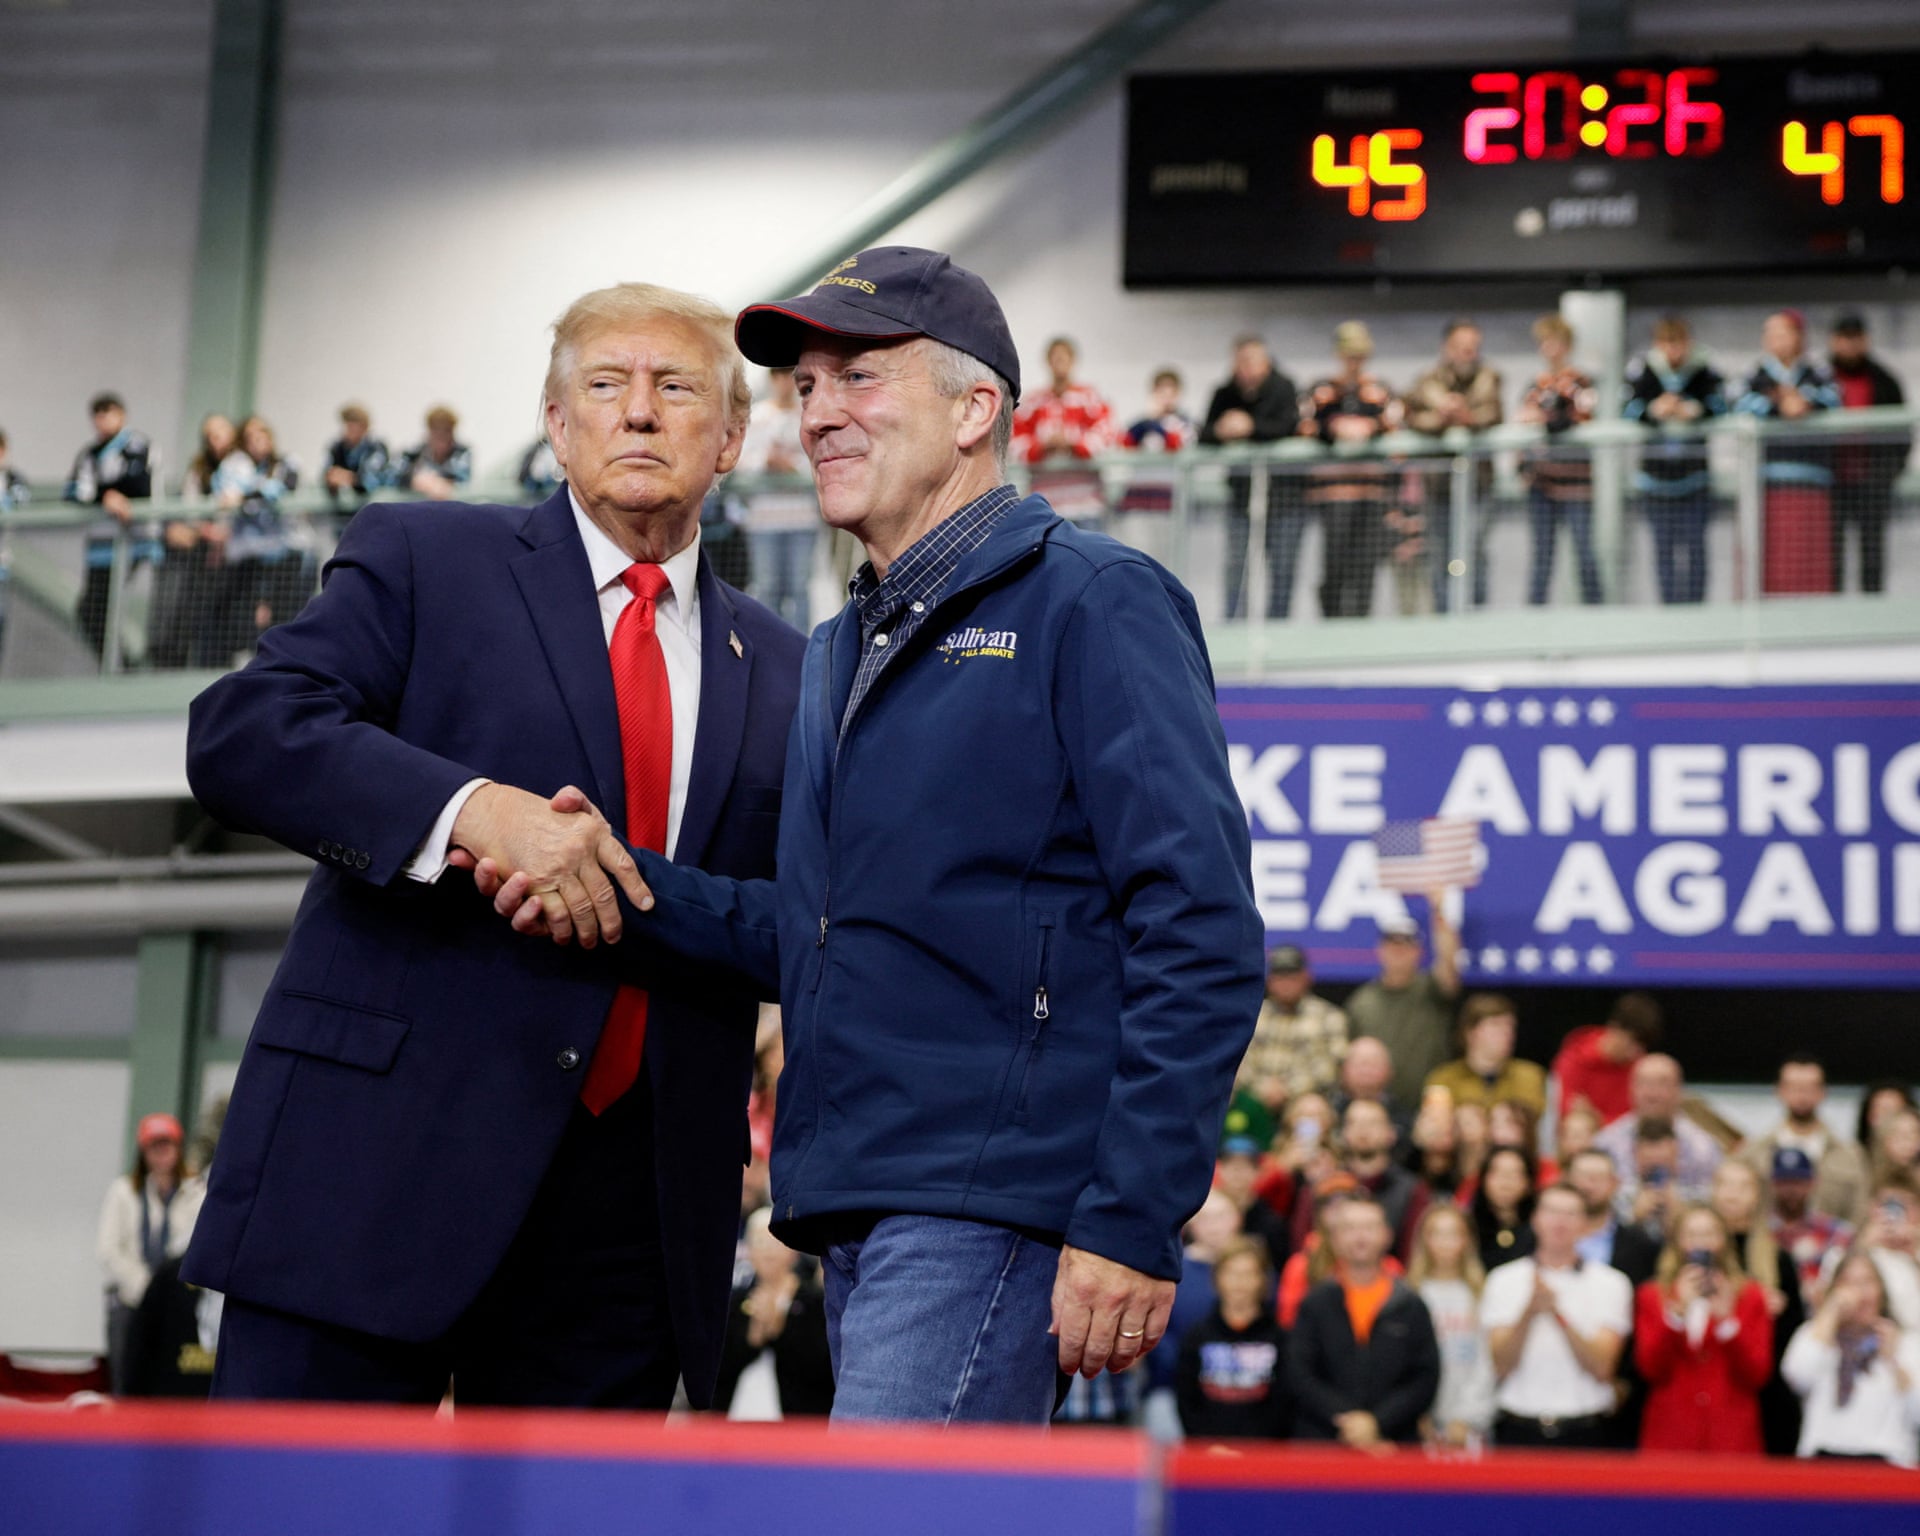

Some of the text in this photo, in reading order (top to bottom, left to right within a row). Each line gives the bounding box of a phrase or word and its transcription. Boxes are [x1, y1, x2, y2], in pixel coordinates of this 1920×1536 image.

[1463, 67, 1724, 164] 20:26
[1782, 114, 1904, 205] 47
[1312, 128, 1427, 221] 45
[980, 647, 1015, 659] SENATE
